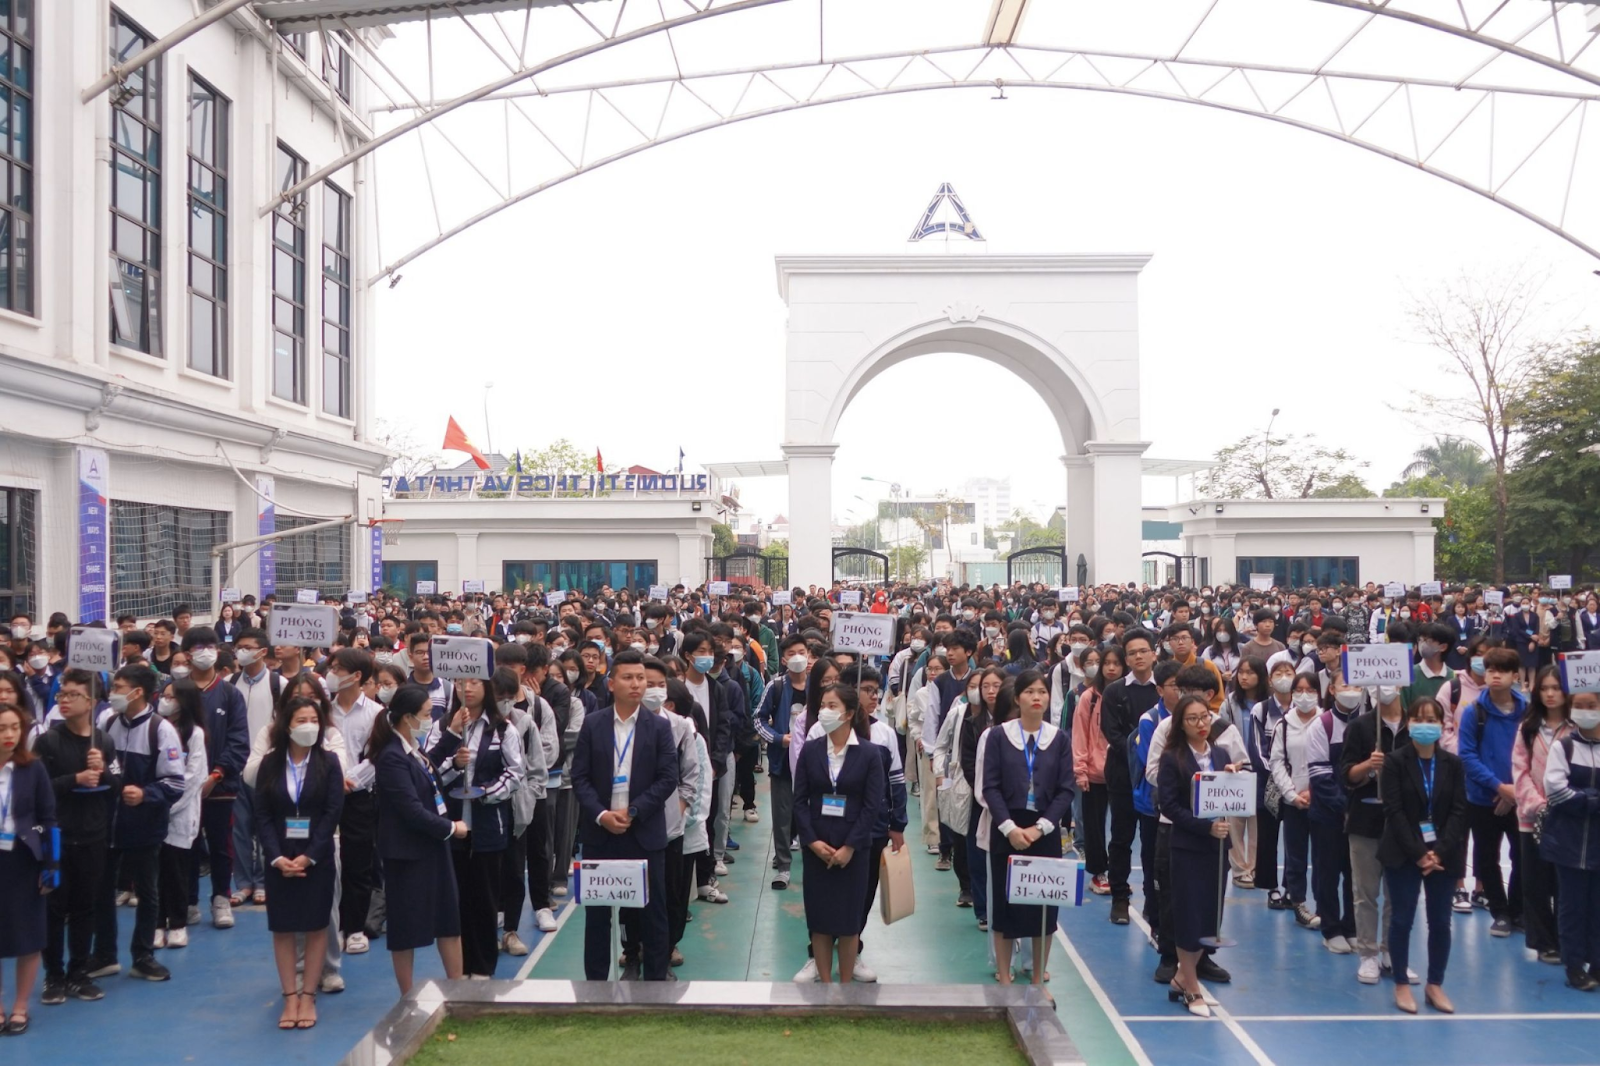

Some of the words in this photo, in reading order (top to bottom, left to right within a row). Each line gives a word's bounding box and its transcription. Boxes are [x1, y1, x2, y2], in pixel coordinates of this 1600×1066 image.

[81, 584, 105, 593] HAPPINESS
[280, 615, 322, 628] PHÒNG
[276, 629, 293, 639] 41-
[297, 630, 325, 641] A203
[843, 624, 882, 636] PHÒNG
[838, 636, 854, 646] 32-
[857, 638, 883, 649] A406
[1356, 655, 1398, 667] PHÒNG
[436, 662, 453, 673] 40-
[456, 664, 481, 675] A207
[1353, 669, 1370, 680] 29-
[1373, 670, 1402, 680] A403
[1573, 677, 1592, 688] 28-
[1207, 785, 1244, 798] PHÒNG
[1203, 800, 1219, 811] 30-
[1221, 801, 1246, 812] A404
[589, 873, 632, 887] PHÒNG
[1020, 871, 1065, 886] PHÒNG
[585, 889, 603, 900] 33-
[606, 889, 637, 901] A407
[1014, 886, 1033, 897] 31-
[1037, 888, 1068, 901] A405
